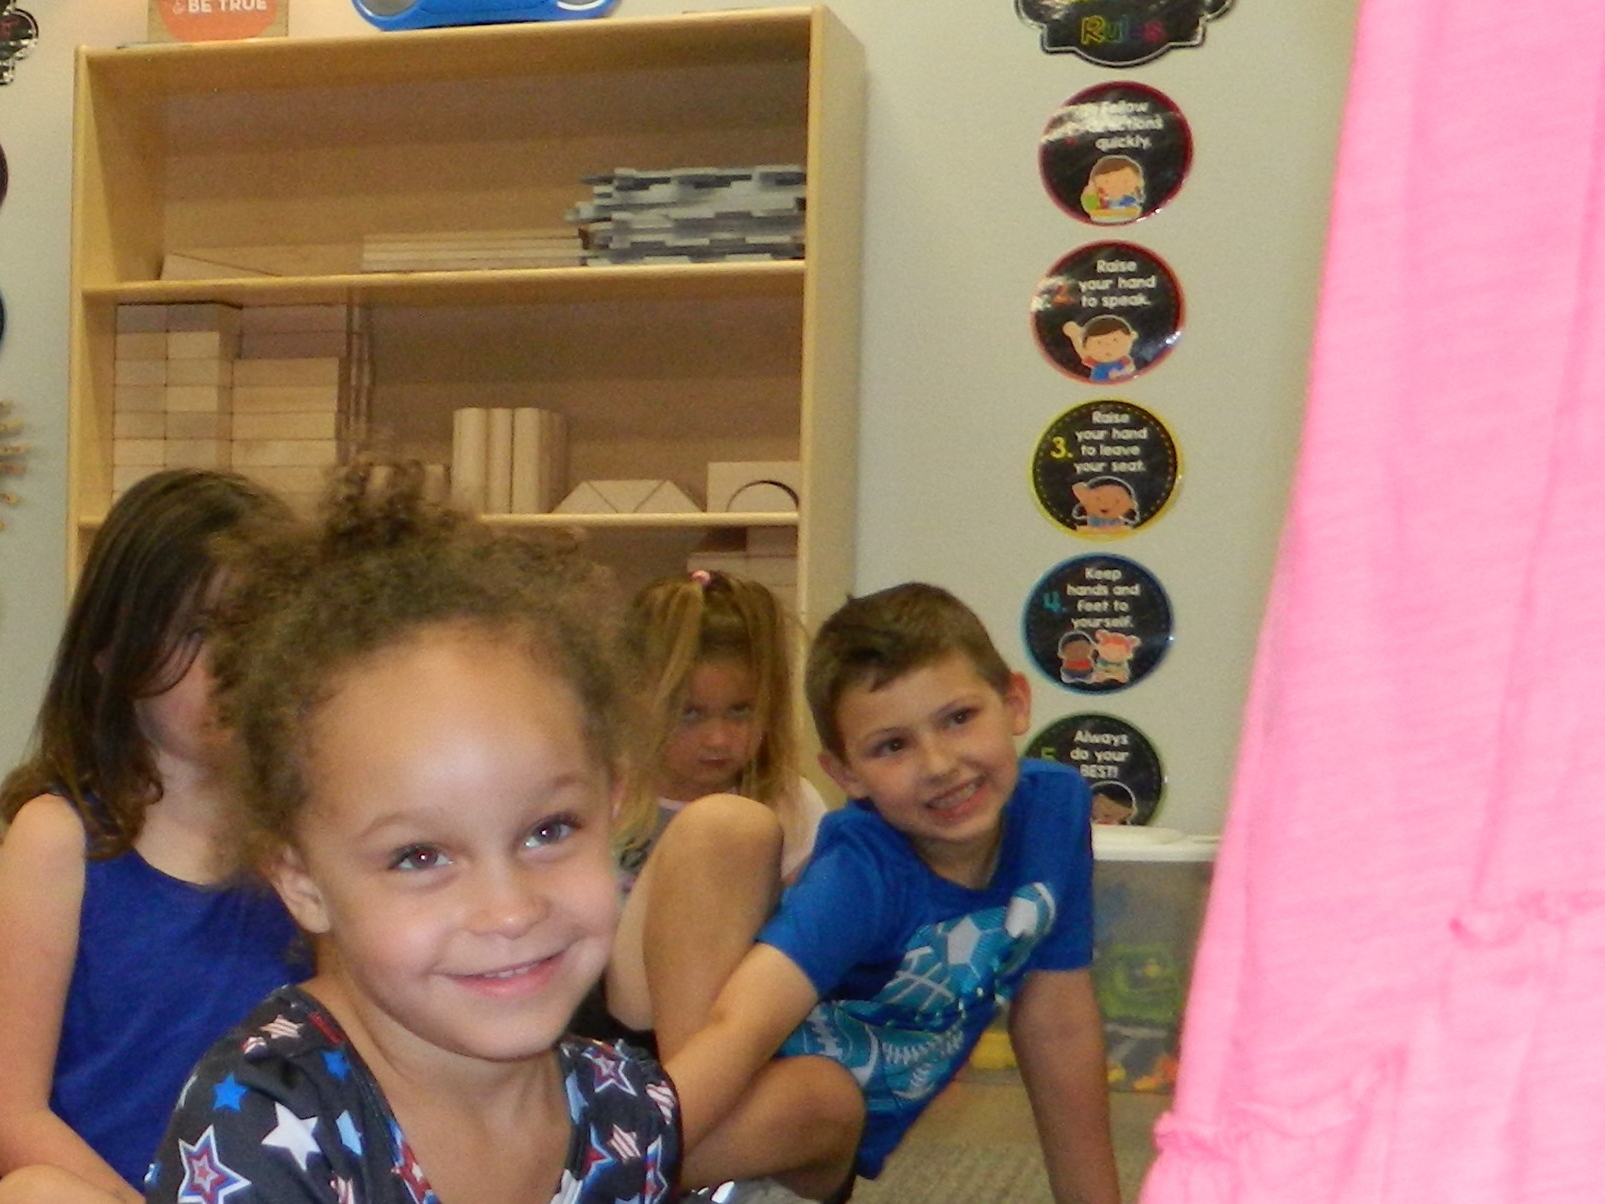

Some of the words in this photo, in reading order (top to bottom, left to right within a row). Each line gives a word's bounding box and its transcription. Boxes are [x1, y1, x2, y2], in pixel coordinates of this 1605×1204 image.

[188, 0, 213, 13] BE
[219, 0, 267, 12] TRUE
[1096, 259, 1138, 273] Raise
[1079, 279, 1114, 293] your
[1117, 275, 1157, 289] hand
[1080, 296, 1098, 308] to
[1091, 410, 1131, 424] Raise
[1075, 429, 1108, 443] your
[1111, 426, 1149, 440] hand
[1080, 444, 1097, 456] to
[1099, 443, 1141, 457] leave
[1073, 461, 1108, 475] your
[1084, 567, 1123, 582] Keep
[1066, 582, 1110, 597] hands
[1112, 583, 1142, 597] and
[1112, 599, 1130, 613] to
[1074, 730, 1130, 747] Always
[1069, 747, 1090, 761] do
[1094, 750, 1131, 763] your
